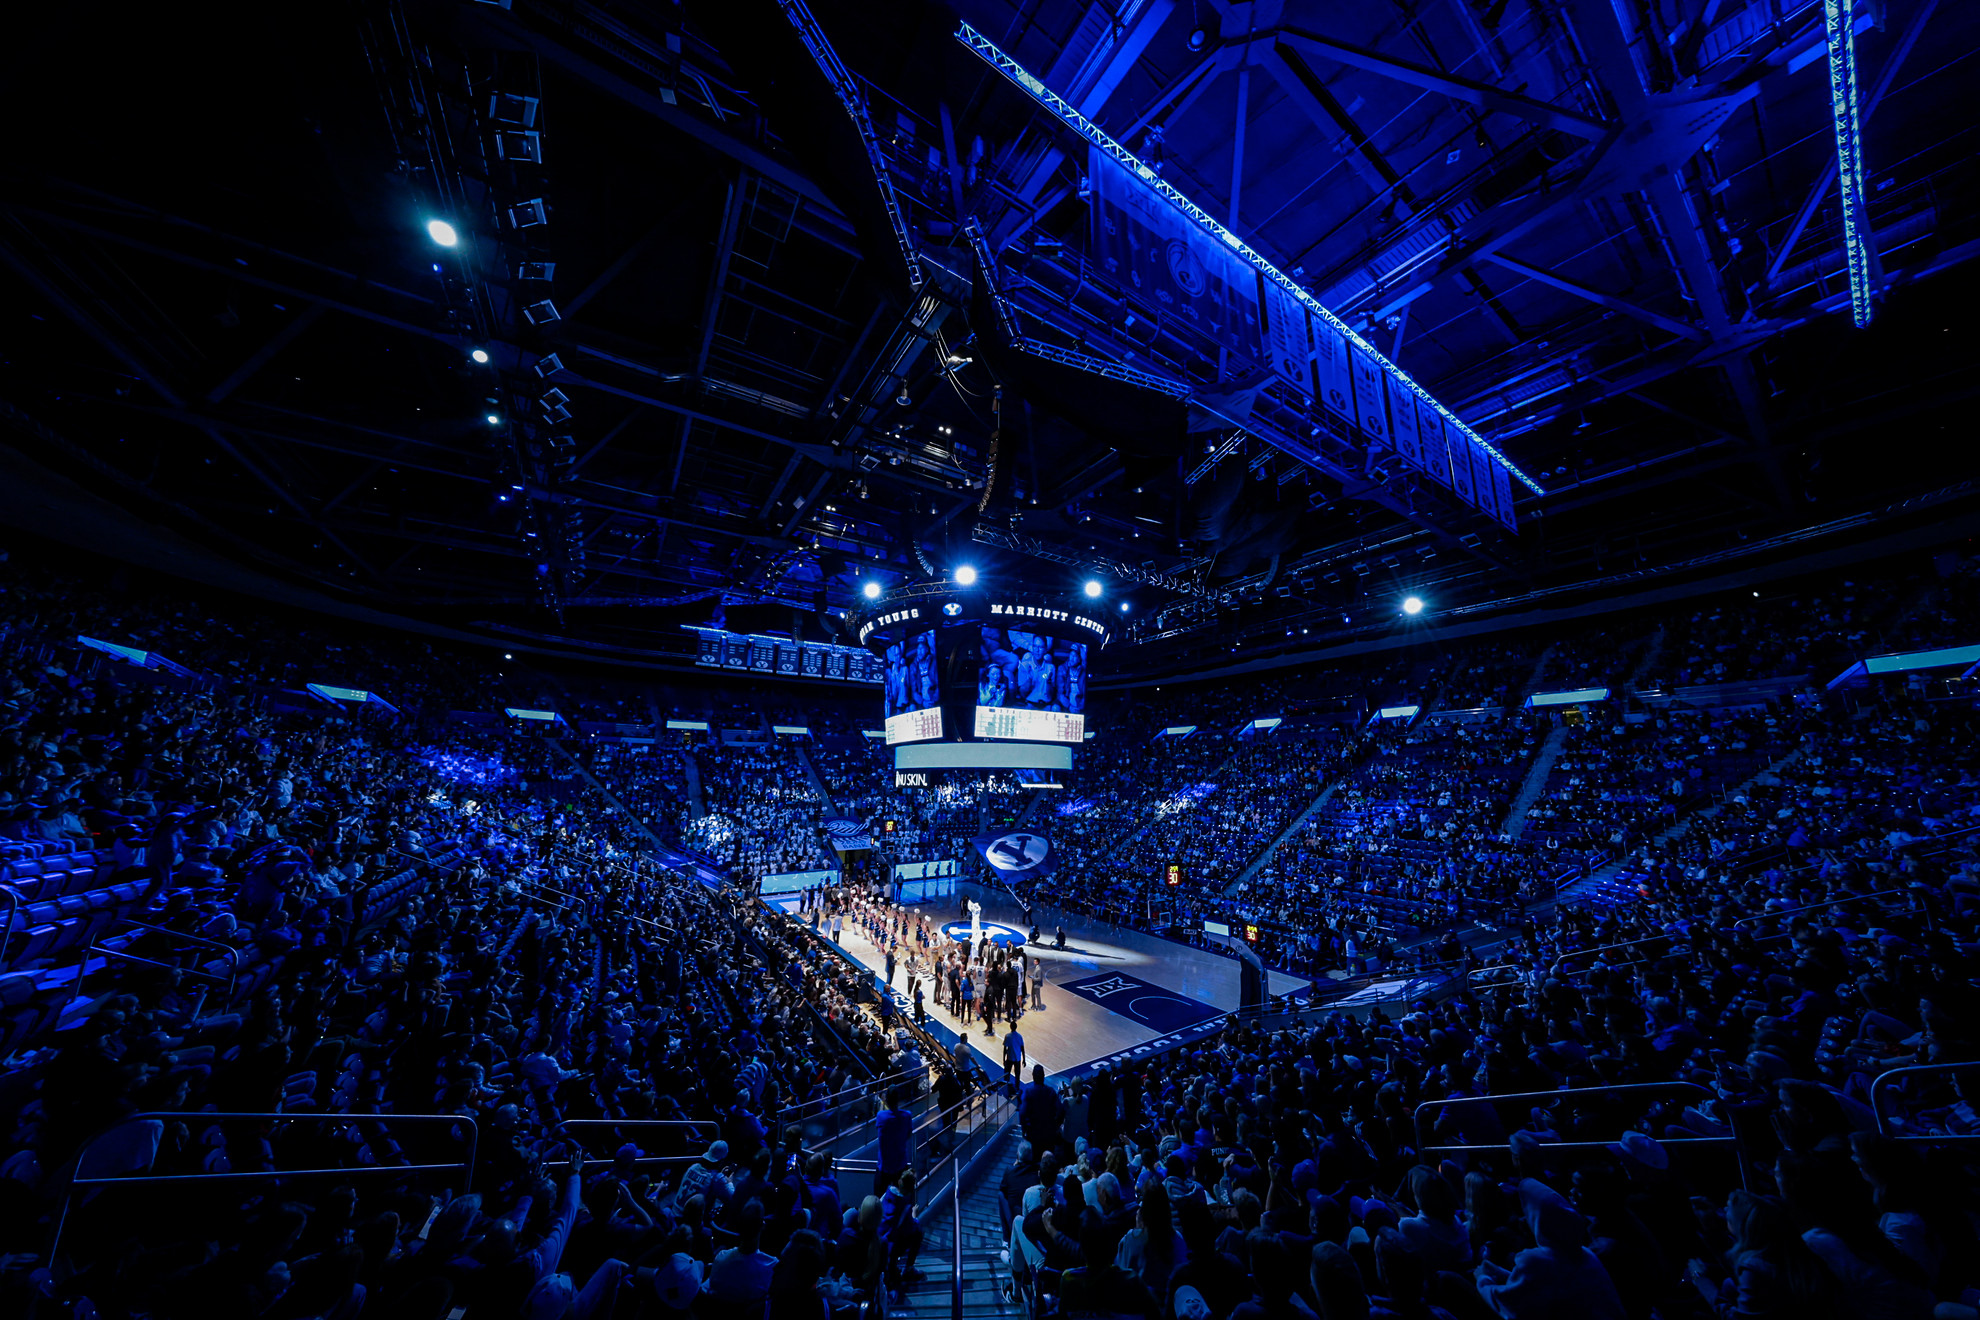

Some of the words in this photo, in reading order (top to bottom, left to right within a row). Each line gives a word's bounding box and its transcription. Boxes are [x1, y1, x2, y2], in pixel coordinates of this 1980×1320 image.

[878, 608, 919, 626] YOUNG
[991, 604, 1069, 621] MARRIOTT
[1169, 873, 1178, 884] 30
